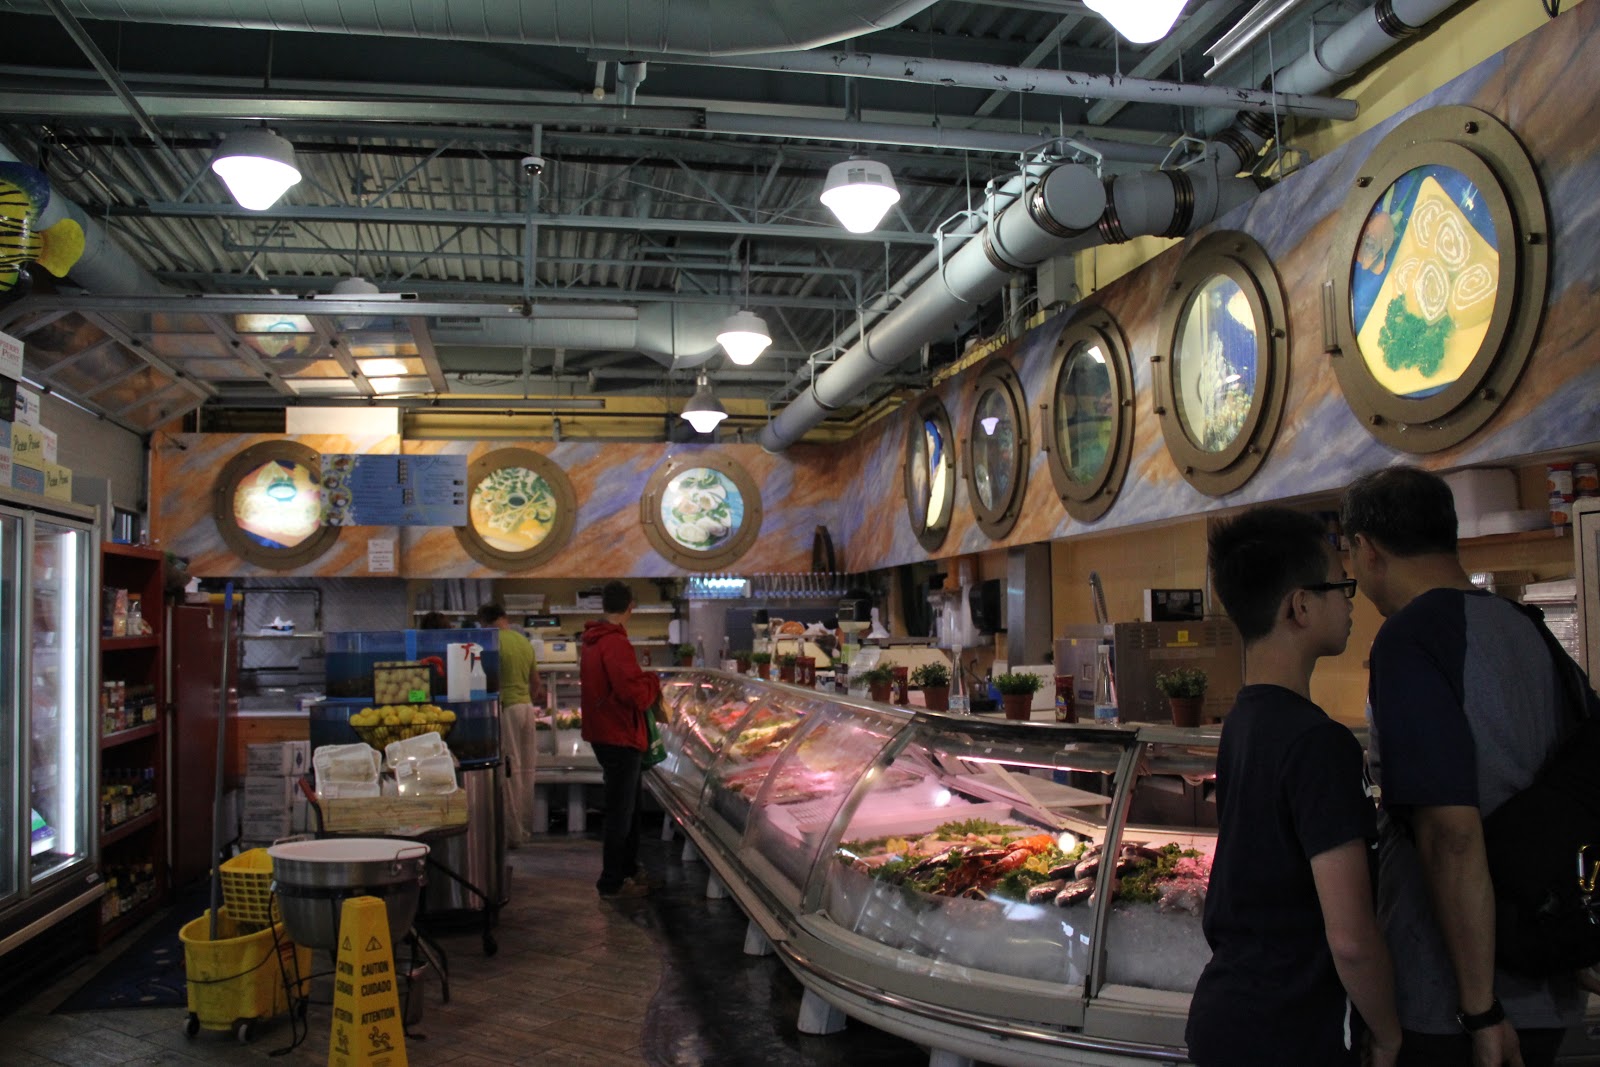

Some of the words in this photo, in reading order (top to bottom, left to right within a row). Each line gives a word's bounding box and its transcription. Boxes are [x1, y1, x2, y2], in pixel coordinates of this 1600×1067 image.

[361, 960, 389, 977] CAUTION
[361, 979, 392, 997] CUIDADO
[361, 1006, 396, 1025] ATTENTION
